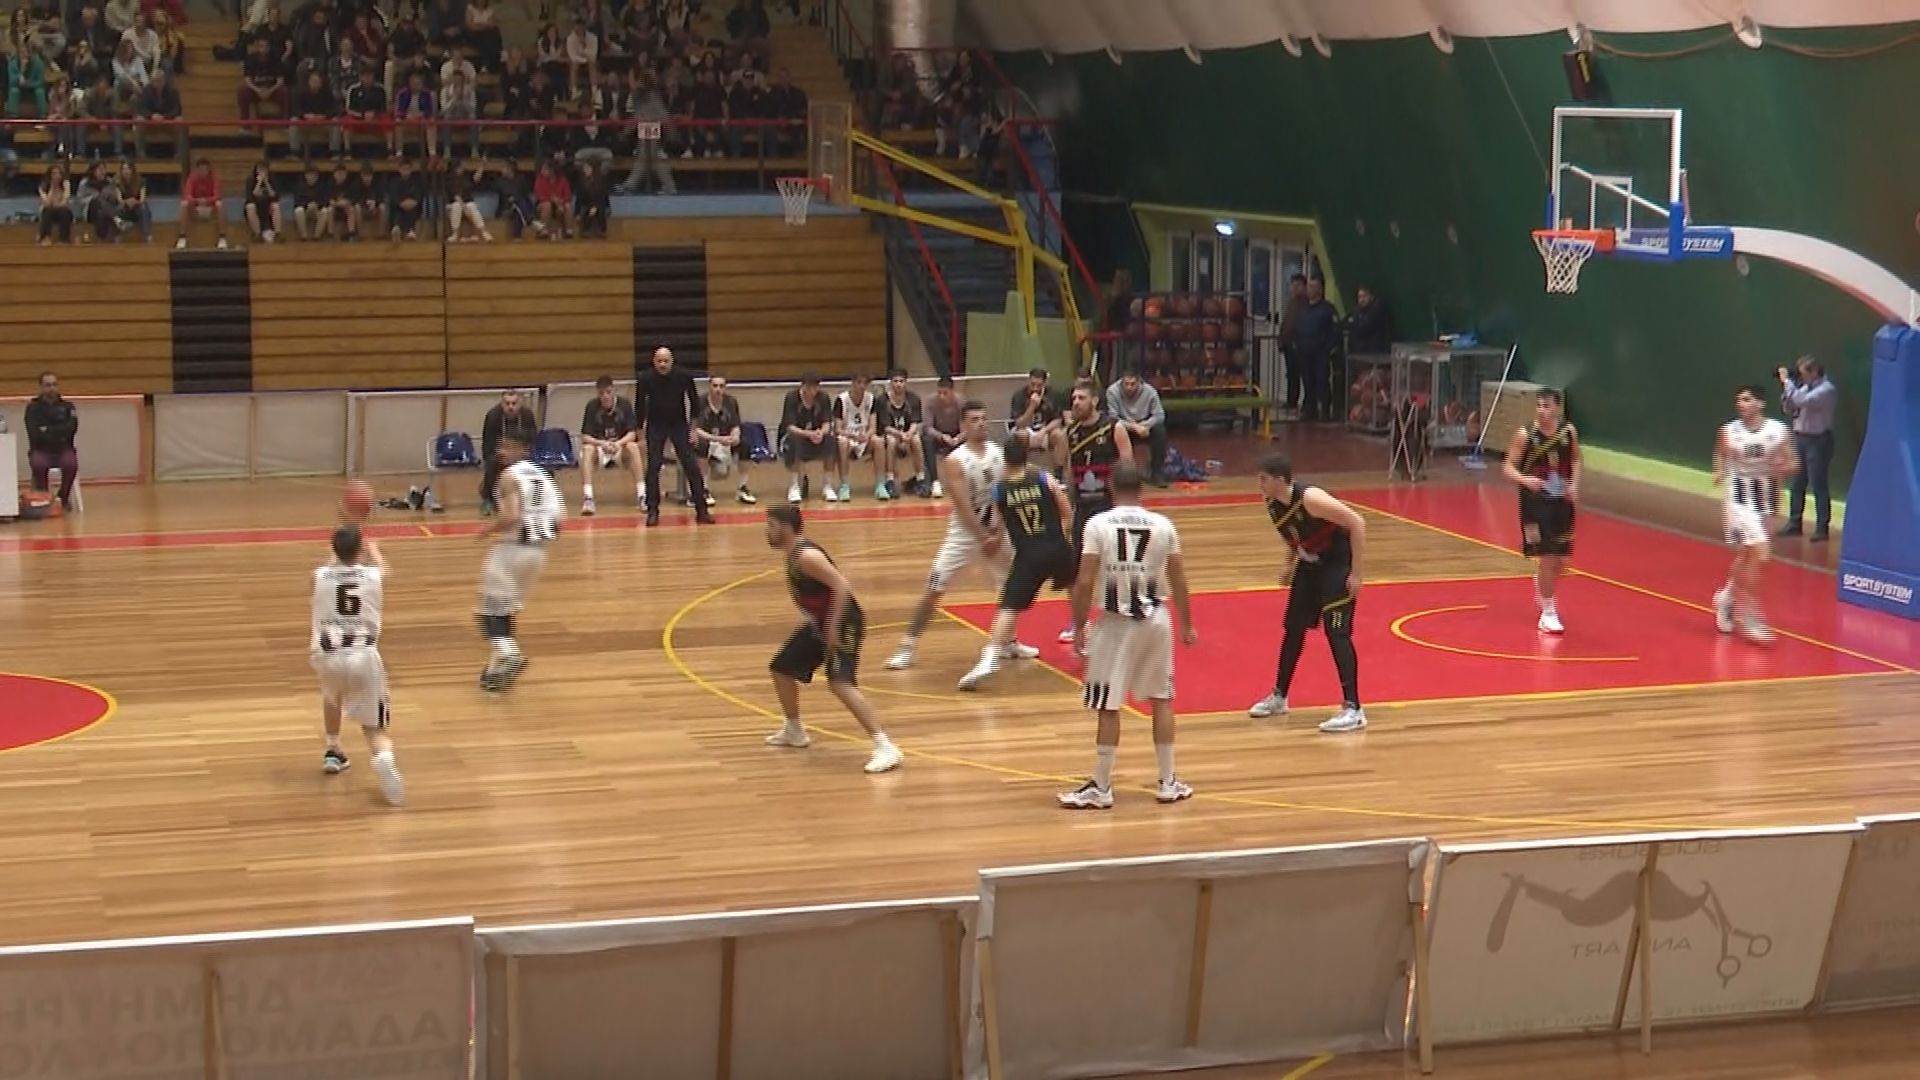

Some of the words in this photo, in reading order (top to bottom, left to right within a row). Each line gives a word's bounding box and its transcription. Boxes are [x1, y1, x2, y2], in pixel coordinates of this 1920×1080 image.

[1015, 504, 1046, 535] 12
[1116, 528, 1151, 562] 17
[336, 583, 362, 615] 6
[1843, 573, 1912, 601] SPORTSYSTEM
